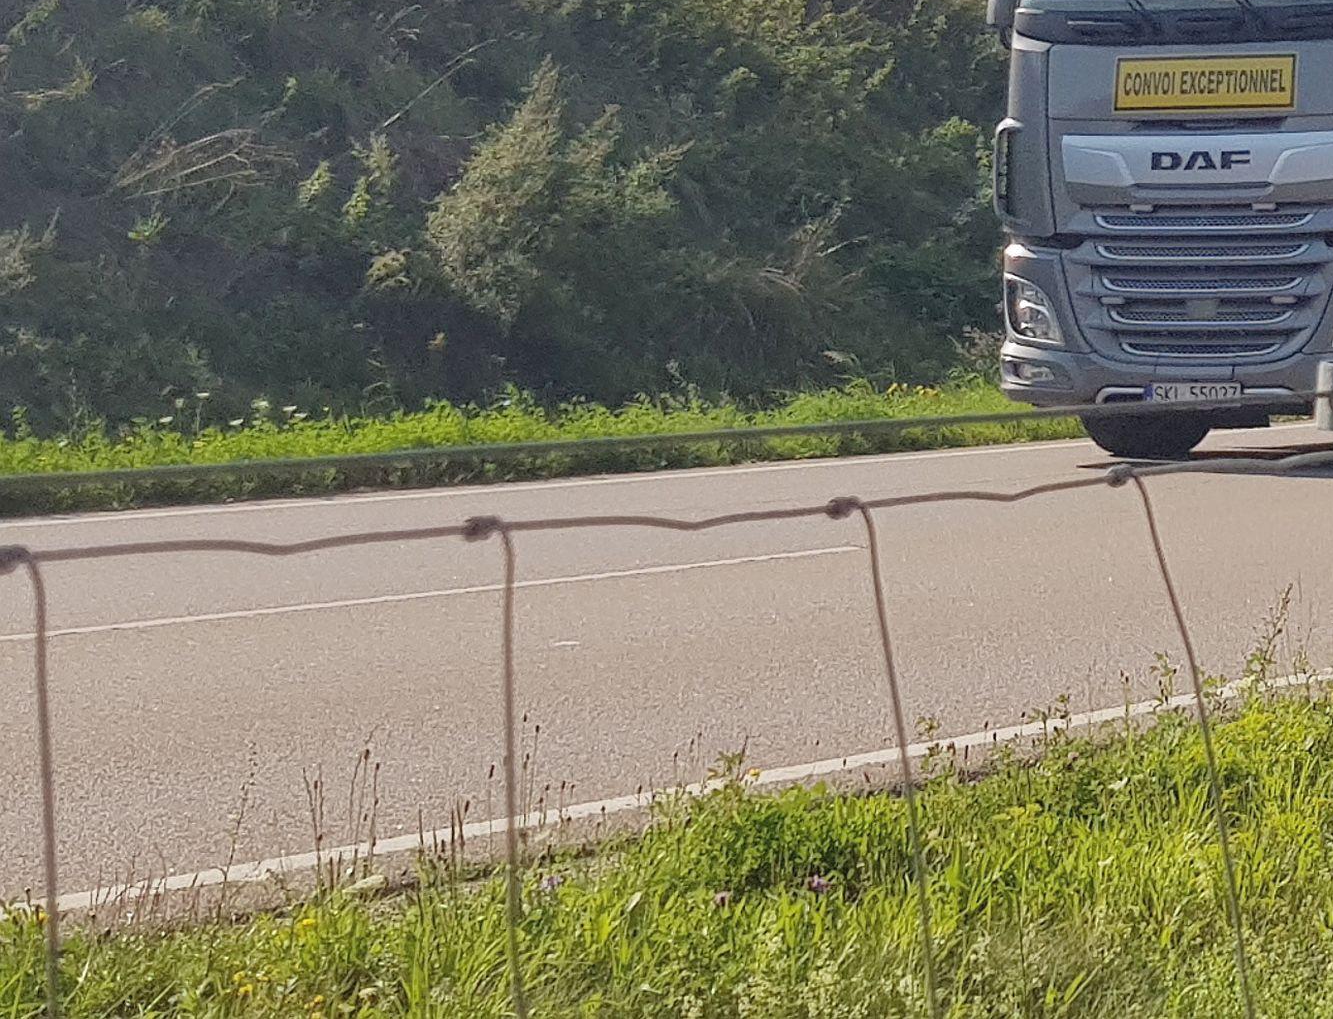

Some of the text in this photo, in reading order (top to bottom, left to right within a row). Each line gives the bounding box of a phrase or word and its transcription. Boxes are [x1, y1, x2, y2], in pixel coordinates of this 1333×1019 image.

[1123, 68, 1287, 97] CONVOI EXCEPTIONNEL
[1151, 149, 1251, 171] DAF
